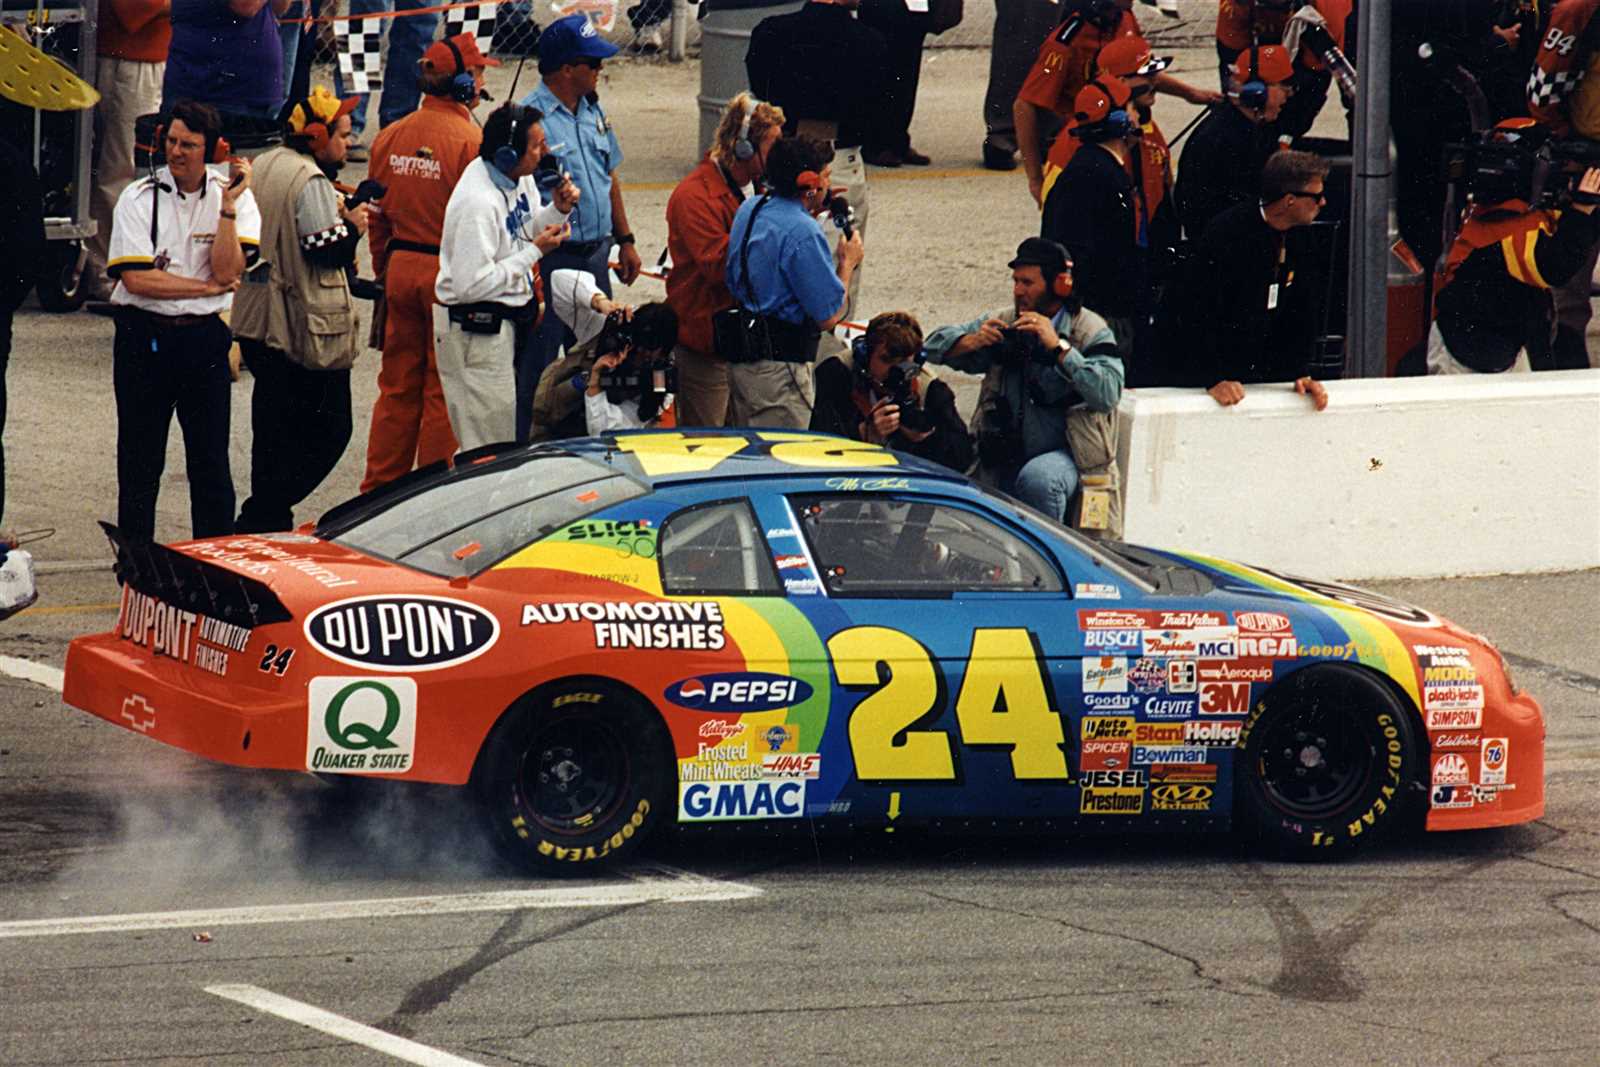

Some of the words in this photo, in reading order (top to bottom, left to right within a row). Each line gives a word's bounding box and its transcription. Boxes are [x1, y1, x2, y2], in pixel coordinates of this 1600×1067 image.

[1544, 28, 1576, 56] 94
[390, 154, 441, 173] DAYTONA
[616, 537, 656, 559] 50
[520, 601, 723, 625] AUTOMOTIVE
[1125, 617, 1145, 628] Cup
[200, 616, 252, 652] AUTOMOTIVE
[595, 623, 725, 650] FINISHES
[1085, 630, 1138, 646] BUSCH
[1199, 642, 1234, 656] MCI
[1240, 638, 1297, 656] RCA
[195, 643, 229, 676] FINISHES
[259, 645, 295, 676] 24
[1220, 662, 1273, 681] Aeroquip
[1424, 667, 1476, 681] MOOG
[709, 681, 797, 703] PEPSI
[1202, 684, 1249, 713] 3M
[827, 625, 1070, 781] 24
[1084, 695, 1139, 709] Goody's
[1145, 697, 1195, 714] CLEVITE
[325, 680, 400, 750] Q
[1099, 719, 1127, 728] Auto
[1431, 711, 1477, 726] SIMPSON
[701, 720, 745, 738] Kellogg's
[1096, 728, 1132, 738] Meter
[1186, 722, 1242, 742] Holley
[698, 741, 747, 761] Frosted
[1084, 742, 1129, 753] SPICER
[1134, 747, 1205, 762] Bowman
[1488, 748, 1502, 762] 76
[312, 746, 366, 769] QUAKER
[370, 753, 409, 768] STATE
[763, 756, 820, 771] HAAS
[1081, 771, 1148, 788] JESEL
[684, 783, 801, 818] GMAC
[1083, 789, 1141, 811] Prestone
